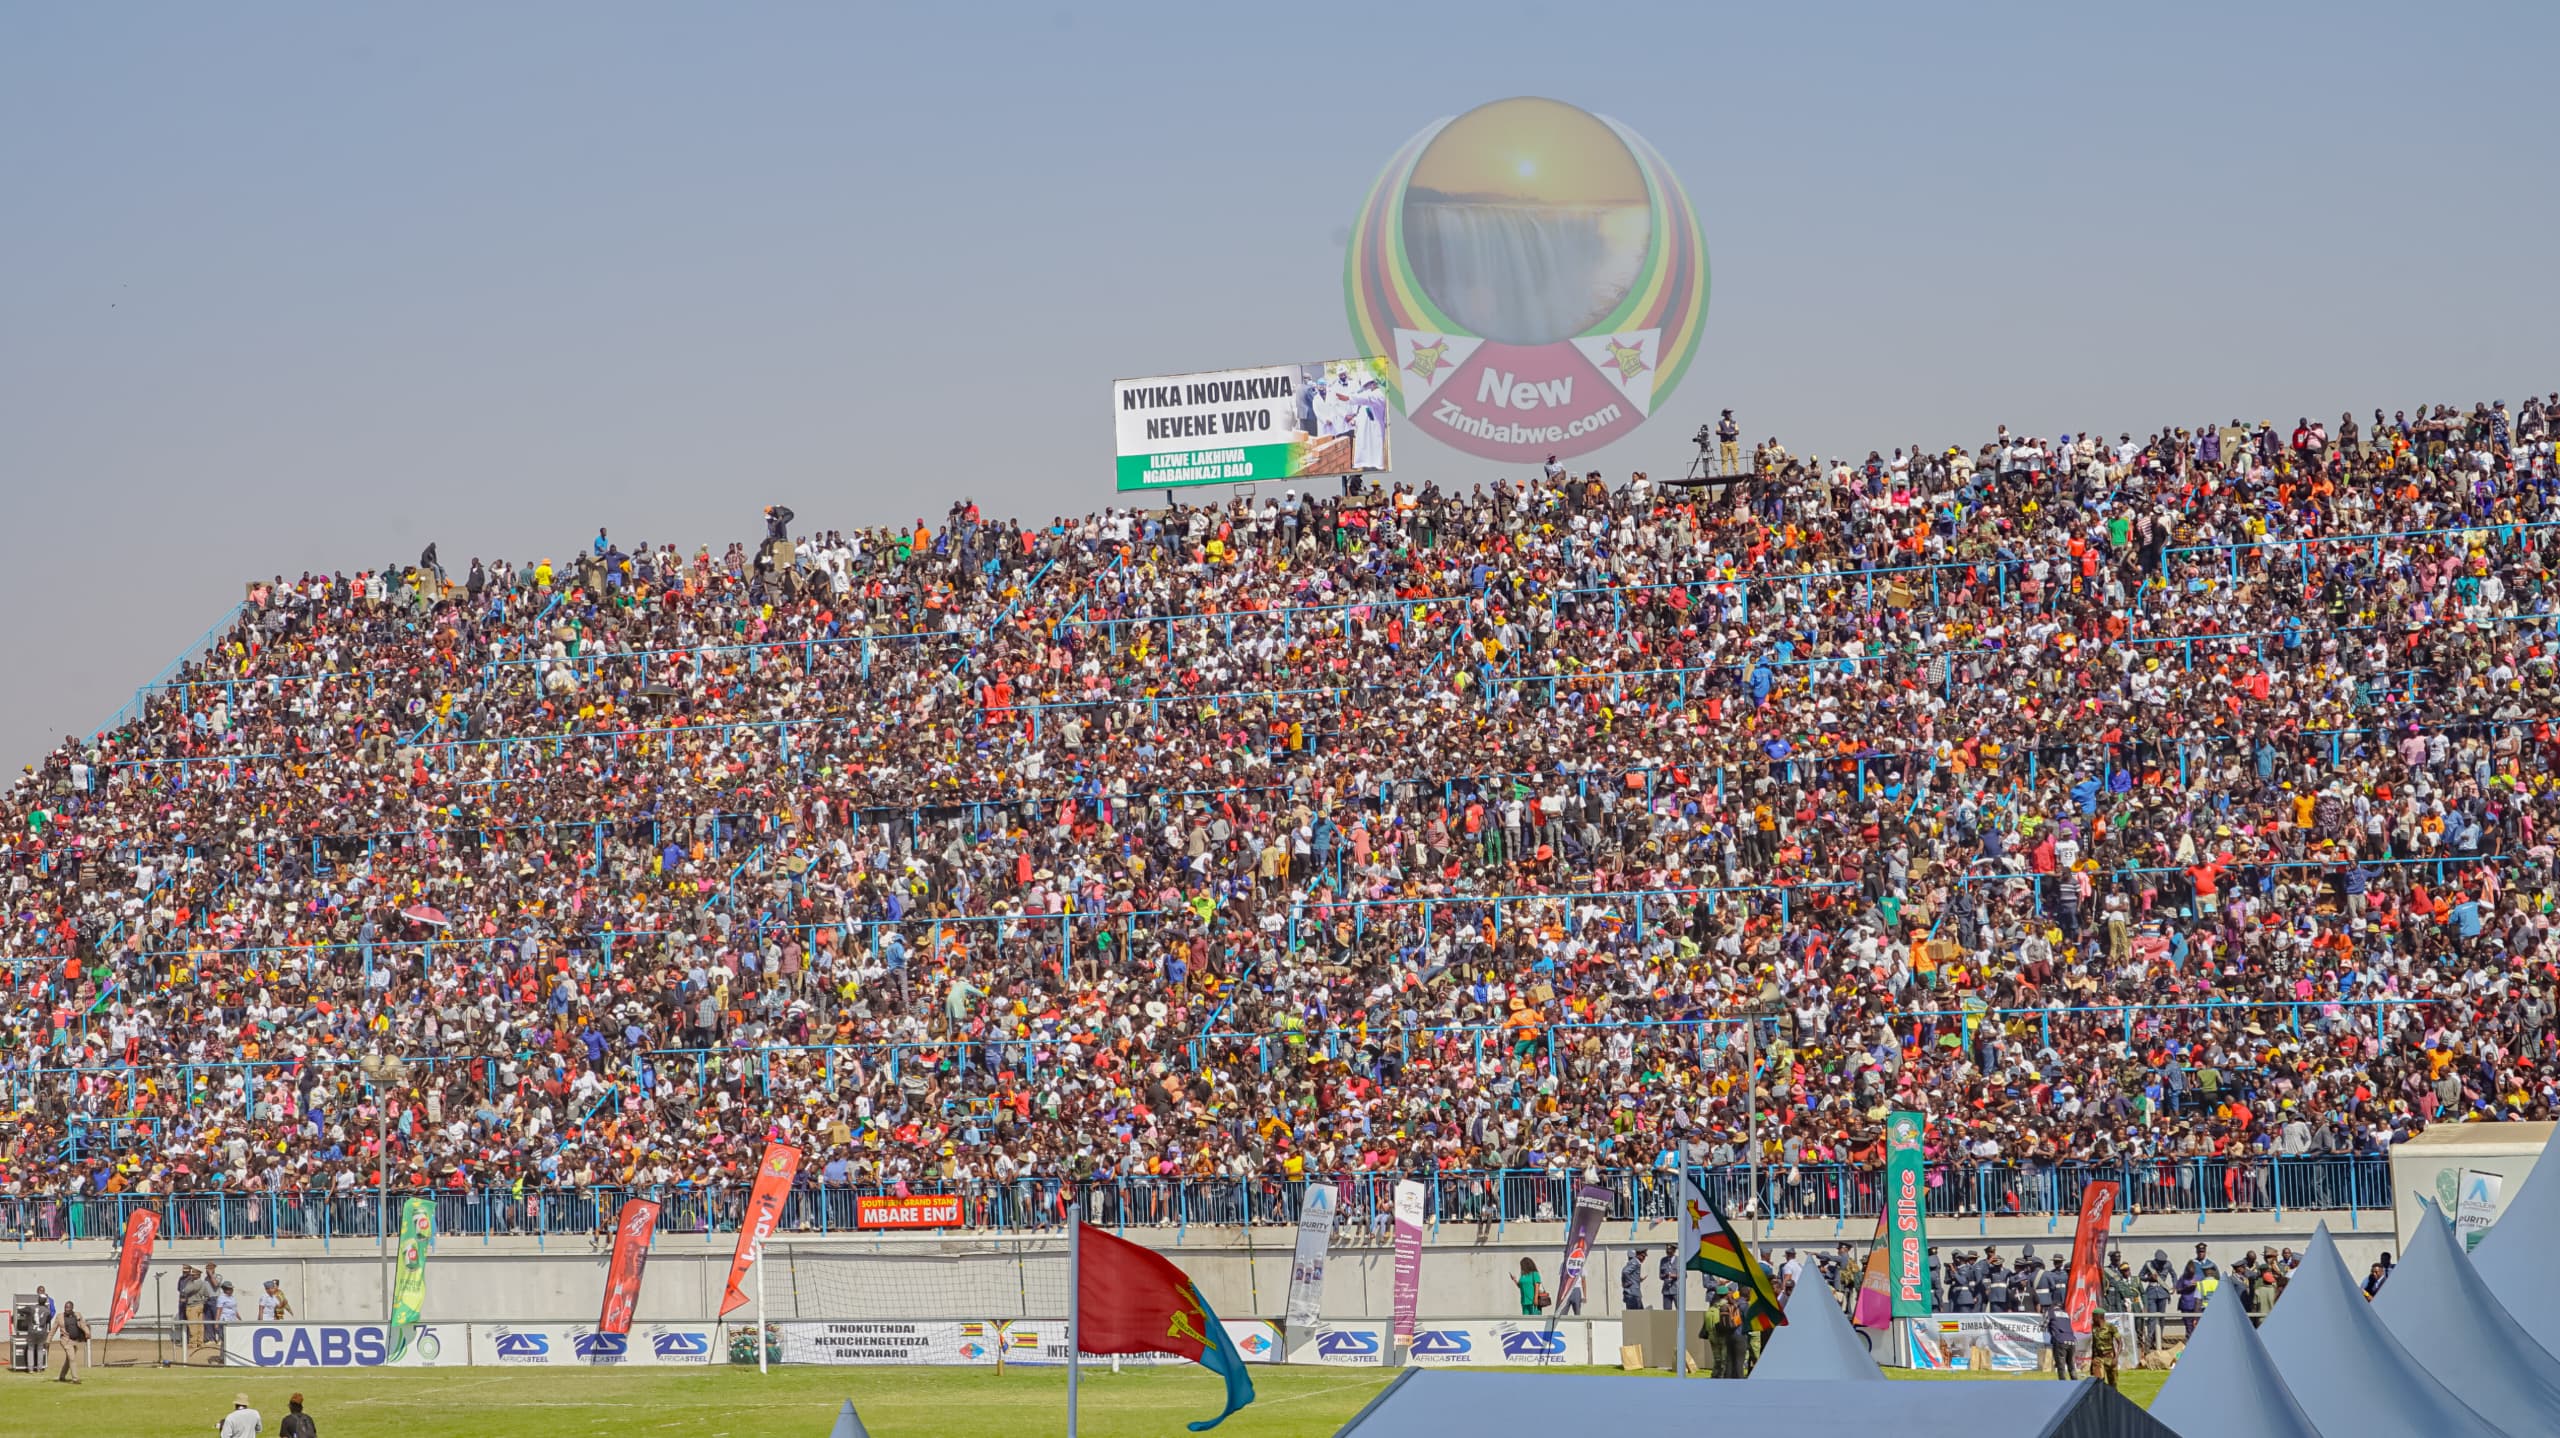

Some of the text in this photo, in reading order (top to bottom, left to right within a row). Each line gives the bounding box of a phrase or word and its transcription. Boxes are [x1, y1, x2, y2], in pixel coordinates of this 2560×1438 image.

[1123, 376, 1293, 410] NYIKA INOVAKWA
[1147, 409, 1271, 440] NEVENE VAYO
[1150, 449, 1245, 469] ILIZWE LAKHIWA
[1143, 462, 1253, 484] NGABANIKAZI BALO
[903, 1198, 931, 1206] GRAND
[933, 1198, 957, 1206] STAND
[1898, 1169, 1918, 1232] Slice
[864, 1206, 957, 1223] MBARE END
[2458, 1215, 2492, 1225] PURITY
[1300, 1221, 1330, 1230] PURITY
[1900, 1237, 1922, 1301] Pizza
[827, 1324, 915, 1334] TINOKUTENDAI
[252, 1327, 386, 1366] CABS
[414, 1324, 441, 1361] 75
[815, 1336, 929, 1346] NEKUCHENGETEDZA
[836, 1349, 908, 1358] RUNYARARO
